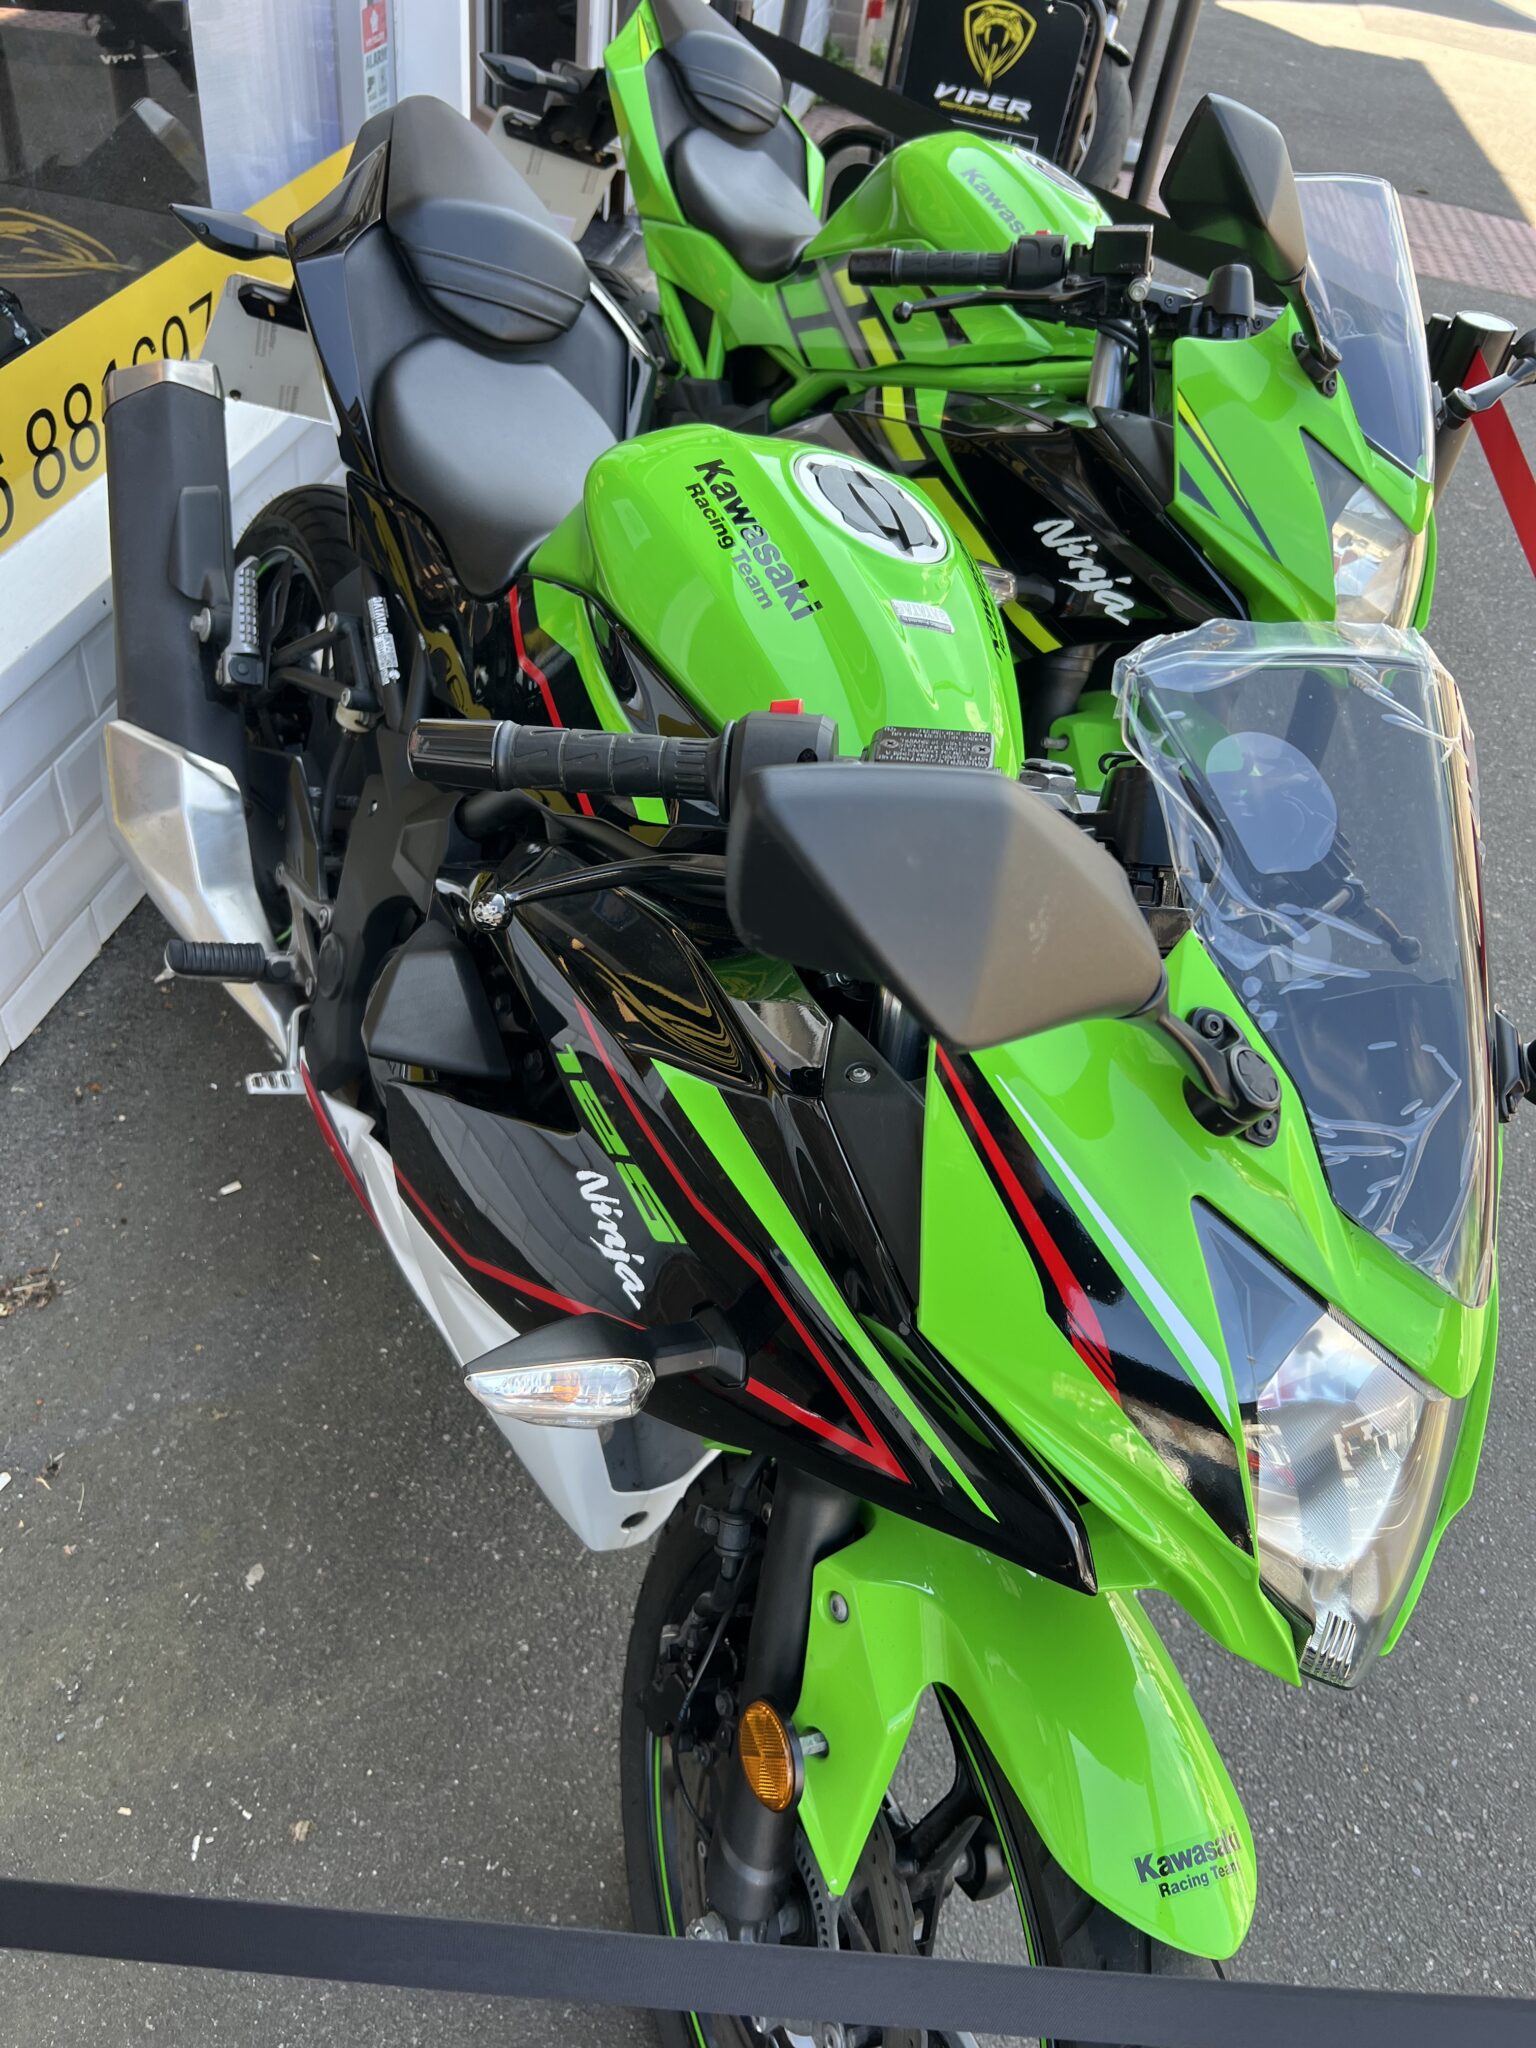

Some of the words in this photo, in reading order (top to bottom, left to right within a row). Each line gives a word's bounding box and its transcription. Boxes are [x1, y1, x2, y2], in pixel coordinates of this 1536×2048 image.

[933, 82, 1032, 121] VIPER
[961, 168, 1029, 235] Kawas
[684, 482, 736, 550] Racing
[732, 548, 773, 609] Team
[694, 458, 824, 621] Kawasaki
[1032, 519, 1135, 626] Ninja
[555, 1043, 688, 1244] 125
[575, 1170, 646, 1311] Ninja
[1158, 1872, 1209, 1898] Racing
